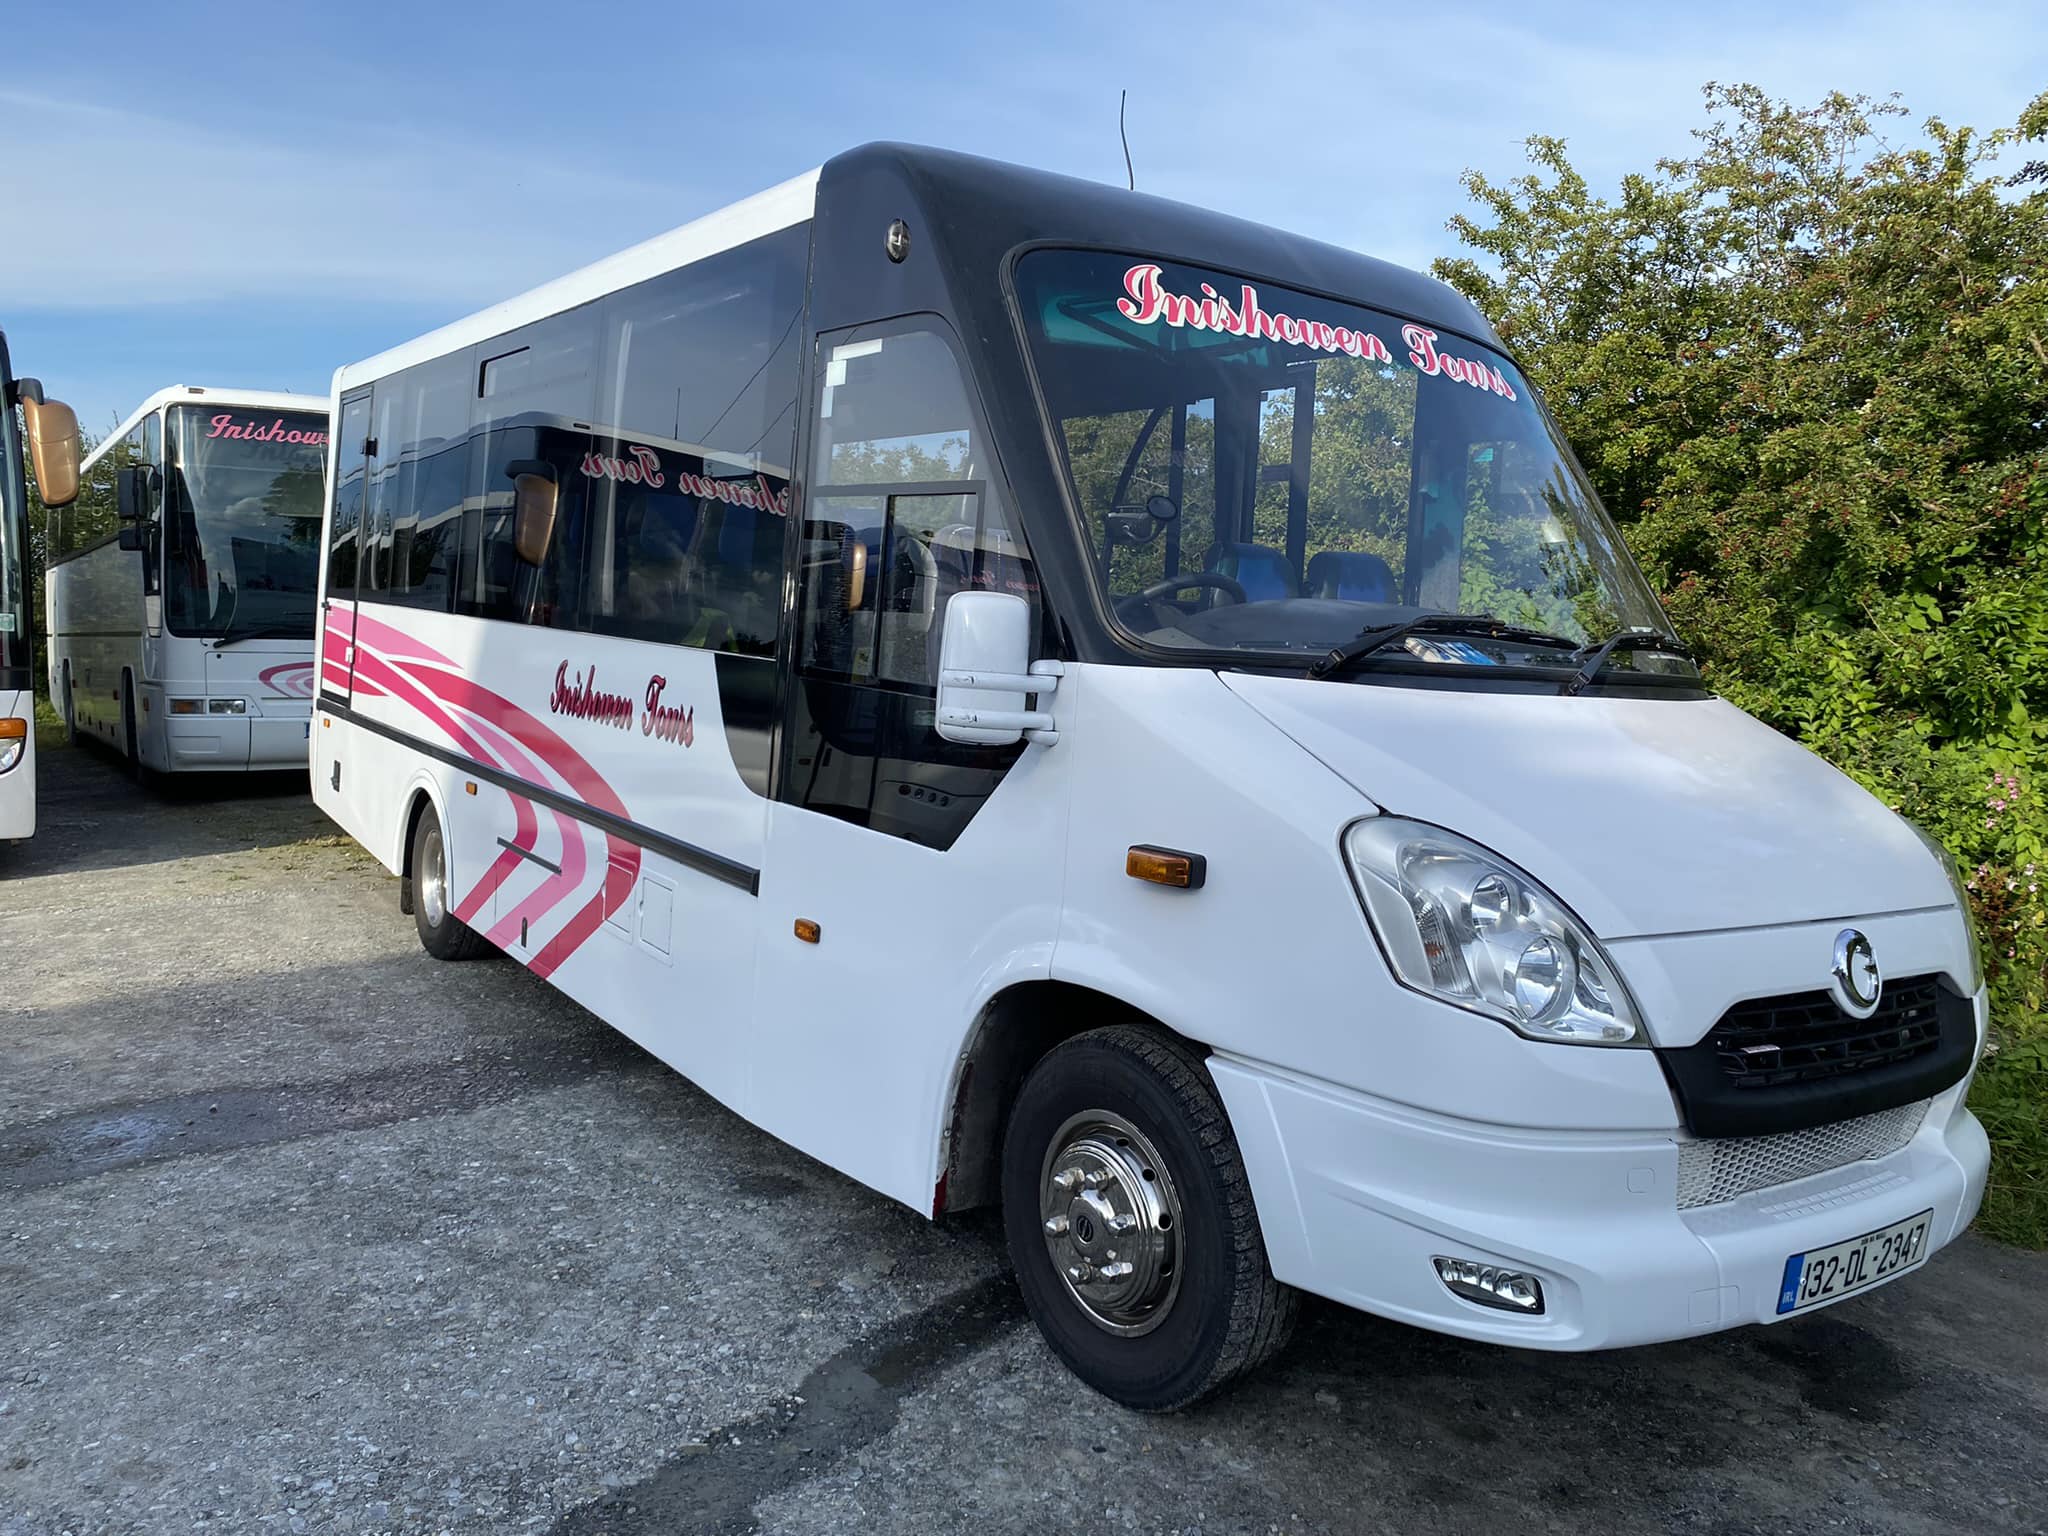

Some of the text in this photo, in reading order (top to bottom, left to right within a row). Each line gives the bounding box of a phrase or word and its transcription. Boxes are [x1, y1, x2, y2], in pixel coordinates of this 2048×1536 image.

[1117, 264, 1516, 402] Inishowen Tours
[550, 659, 694, 748] Inishowen Tours
[1801, 1223, 1925, 1300] 132-DL-2347
